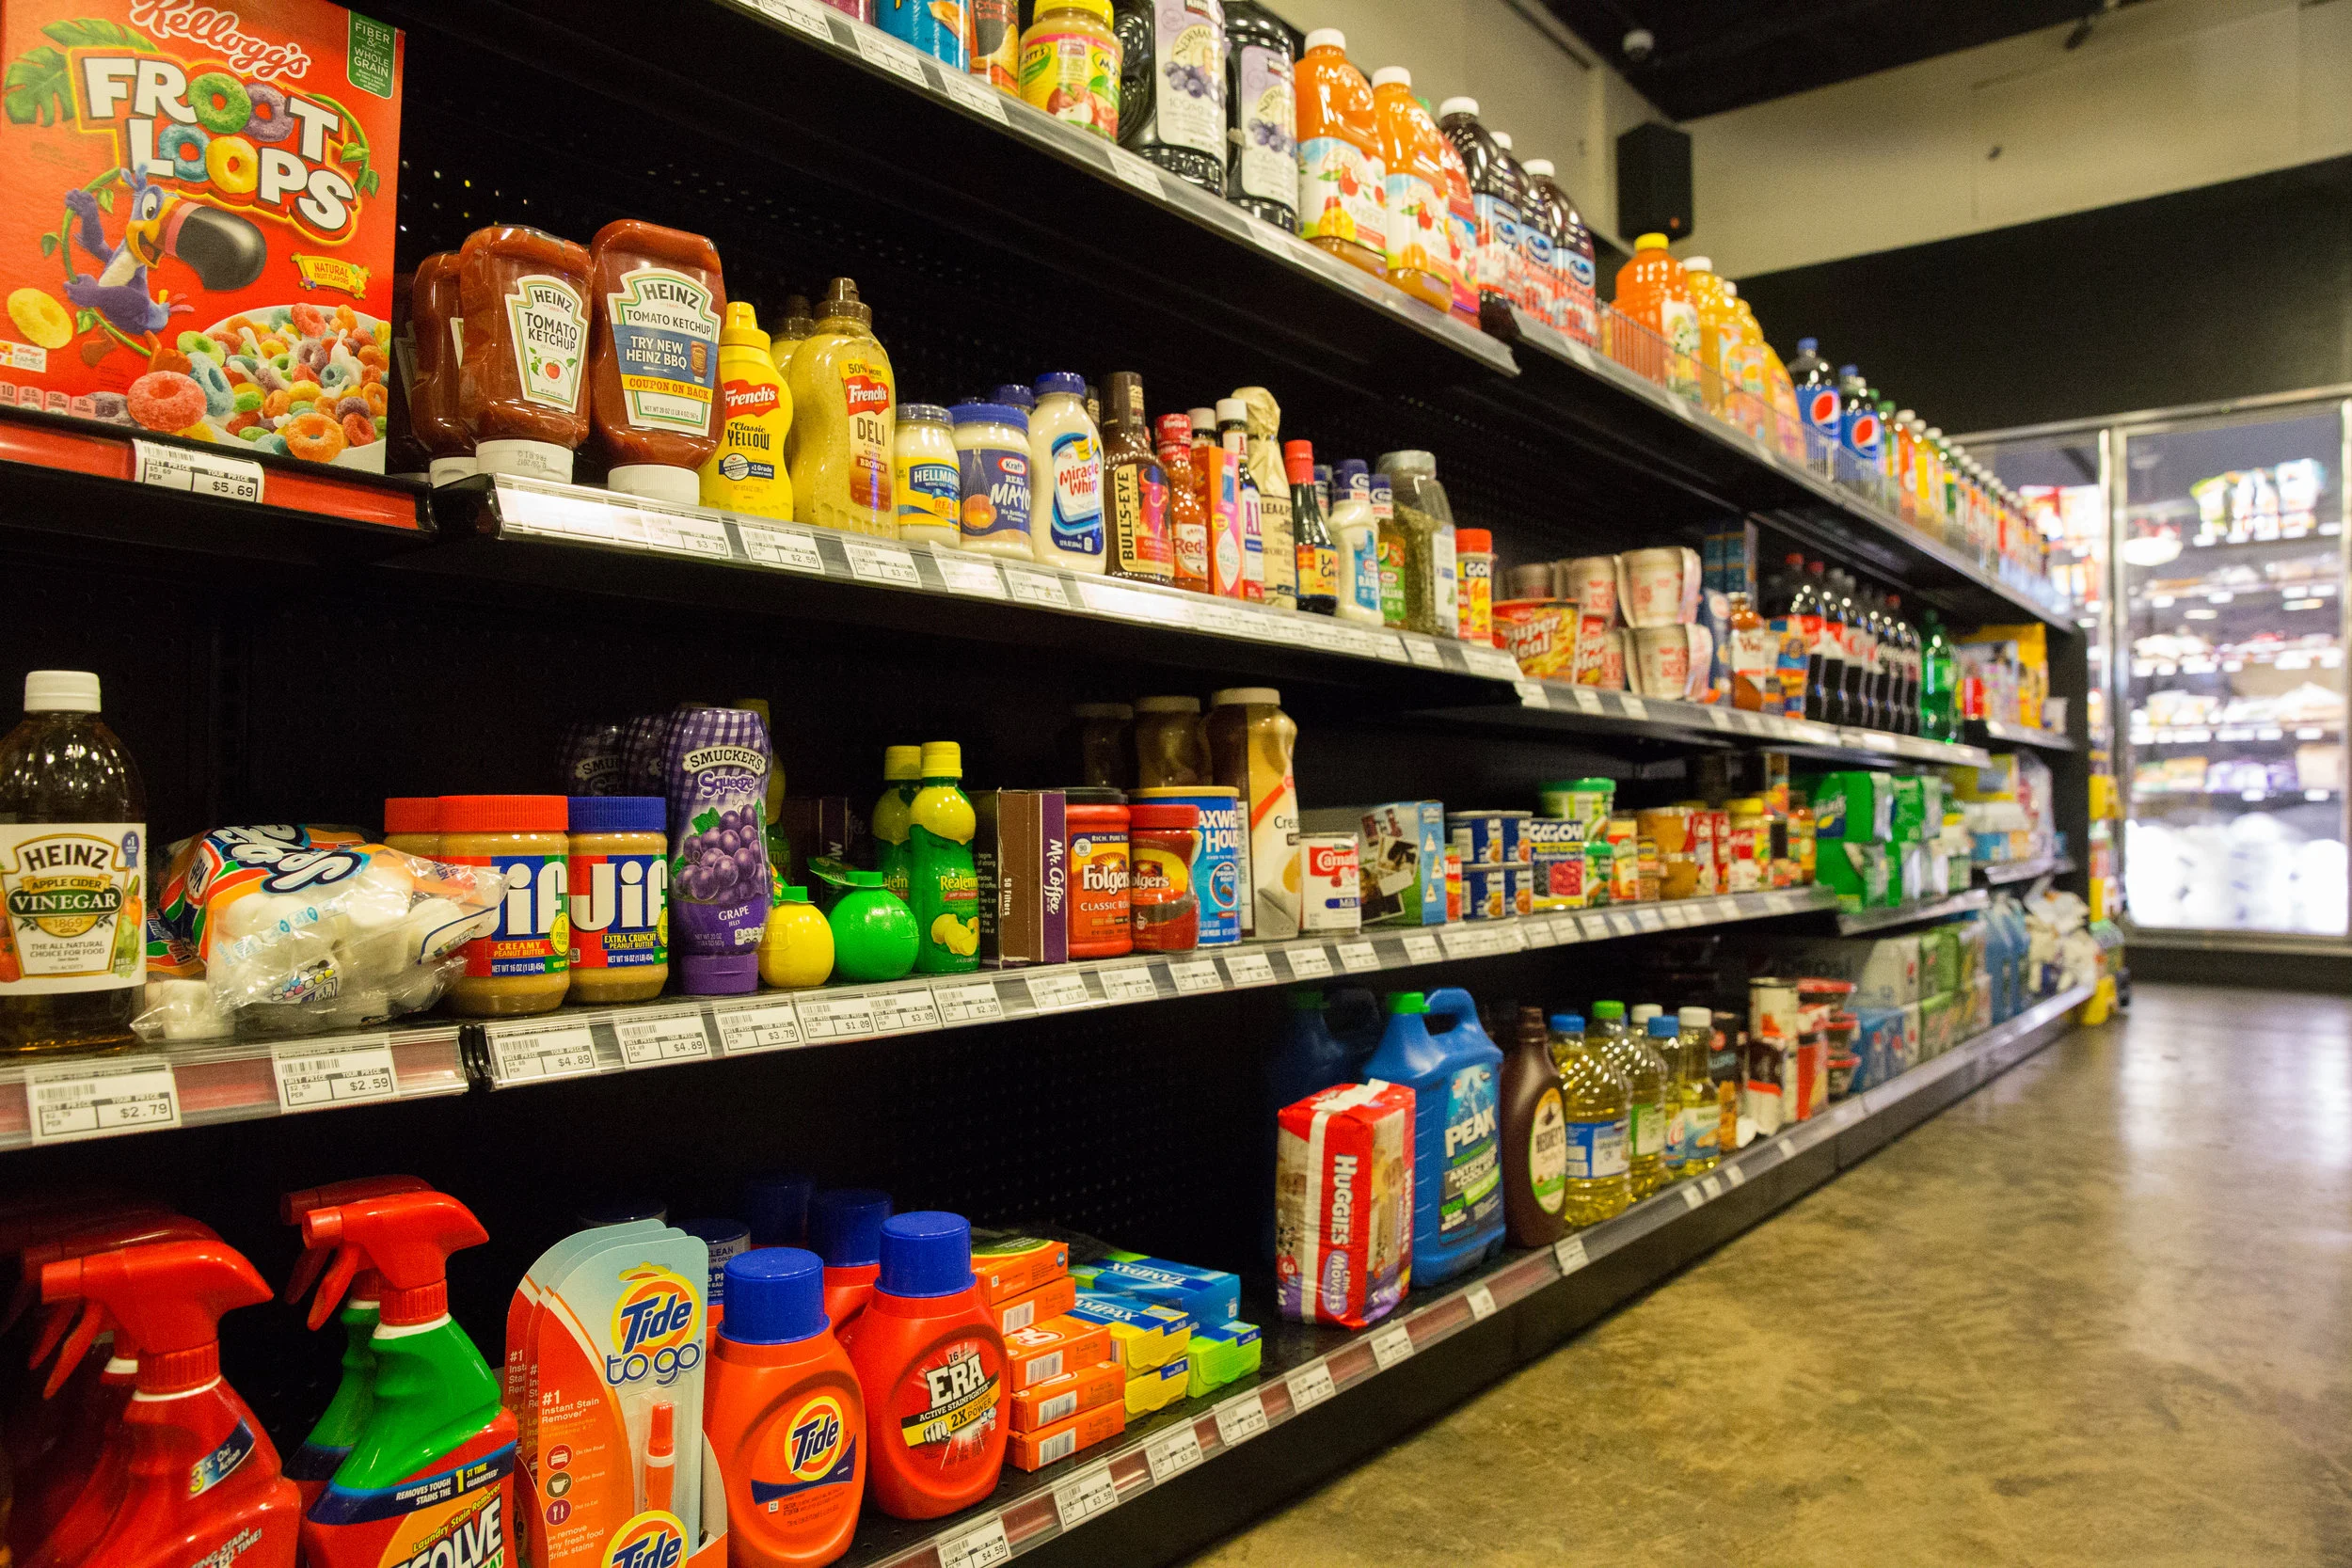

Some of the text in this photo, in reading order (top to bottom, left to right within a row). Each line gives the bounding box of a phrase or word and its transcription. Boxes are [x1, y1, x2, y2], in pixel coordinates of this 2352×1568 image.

[131, 0, 310, 81] Kellogg's
[355, 23, 390, 44] FIBER
[366, 38, 377, 48] &
[353, 56, 389, 78] GRAIN
[354, 46, 389, 68] WHOLE
[81, 57, 340, 164] FROOT
[128, 118, 355, 230] LOOPS
[313, 262, 348, 278] NATURAL
[533, 290, 572, 313] HEINZ
[642, 284, 700, 309] HEINZ
[525, 311, 578, 341] TOMATO
[626, 309, 711, 336] TOMATO KETCHUP
[528, 327, 576, 352] KETCHUP
[629, 335, 684, 355] TRY NEW
[626, 349, 688, 371] HEINZ BBQ
[848, 363, 867, 374] 50%
[628, 377, 709, 400] COUPON ON BACK
[725, 386, 776, 407] French's
[848, 384, 887, 404] French's
[730, 421, 766, 434] Classic
[856, 417, 885, 447] DELI
[727, 429, 771, 451] YELLOW
[859, 458, 886, 472] BROWN
[1005, 460, 1024, 472] Kraft
[1059, 463, 1100, 487] Miracle
[149, 472, 163, 481] PER
[1005, 475, 1025, 485] REAL
[212, 481, 254, 497] $5.69
[989, 483, 1031, 511] MAYO
[1070, 478, 1097, 497] Whip
[934, 499, 955, 512] REAL
[1117, 472, 1135, 561] BULL'S-EYE
[696, 540, 725, 551] $3.79
[790, 553, 817, 564] $2.59
[689, 749, 763, 770] SMUCKER'S
[698, 771, 755, 798] Squeeze
[127, 837, 135, 847] #1
[24, 844, 109, 872] HEINZ
[31, 878, 102, 890] APPLE CIDER
[1043, 838, 1065, 915] Mr. Coffee
[14, 894, 117, 911] VINEGAR
[569, 860, 667, 933] Jif
[1003, 878, 1011, 916] 50 Filters
[1080, 900, 1117, 911] CLASSIC
[54, 917, 83, 928] 1869
[718, 906, 750, 922] GRAPE
[50, 942, 64, 950] ALL
[497, 942, 541, 952] CREAMY
[603, 932, 657, 943] EXTRA CRUNCHY
[609, 941, 654, 950] PEANUT BUTTER
[82, 947, 105, 956] FOOD
[493, 947, 546, 958] PEANUT BUTTER
[607, 954, 635, 962] NET WT 16 OZ
[491, 964, 501, 973] NET
[501, 964, 509, 973] WT
[509, 964, 516, 973] 16
[768, 1029, 795, 1040] $3.79
[673, 1040, 703, 1052] $4.89
[557, 1054, 591, 1068] $4.89
[349, 1077, 389, 1091] $2.59
[119, 1102, 167, 1119] $2.79
[1445, 1105, 1497, 1158] PEAK
[1330, 1153, 1359, 1246] HUGGIES
[1329, 1254, 1346, 1311] Movers
[621, 1293, 692, 1355] Tide
[509, 1350, 523, 1362] #1
[606, 1342, 701, 1385] to go
[949, 1351, 959, 1363] 16
[926, 1354, 986, 1410] ERA
[541, 1397, 599, 1416] Instant Stain
[542, 1389, 561, 1405] #1
[919, 1406, 947, 1422] ACTIVE
[950, 1398, 992, 1428] 2X POWER
[791, 1413, 839, 1474] Tide
[189, 1448, 241, 1493] 3 Action
[455, 1468, 465, 1494] 1
[473, 1463, 487, 1475] TIME
[395, 1478, 452, 1500] REMOVES TOUGH
[416, 1487, 452, 1505] STAINS THE
[412, 1482, 501, 1554] Laundry Stain Remover
[557, 1524, 588, 1537] remove
[564, 1536, 584, 1548] fresh
[586, 1528, 605, 1541] food
[220, 1527, 249, 1555] STAIN
[237, 1528, 263, 1555] TIME!
[612, 1531, 682, 1568] Tide
[548, 1543, 595, 1561] drink stains
[981, 1544, 1005, 1560] $4.59
